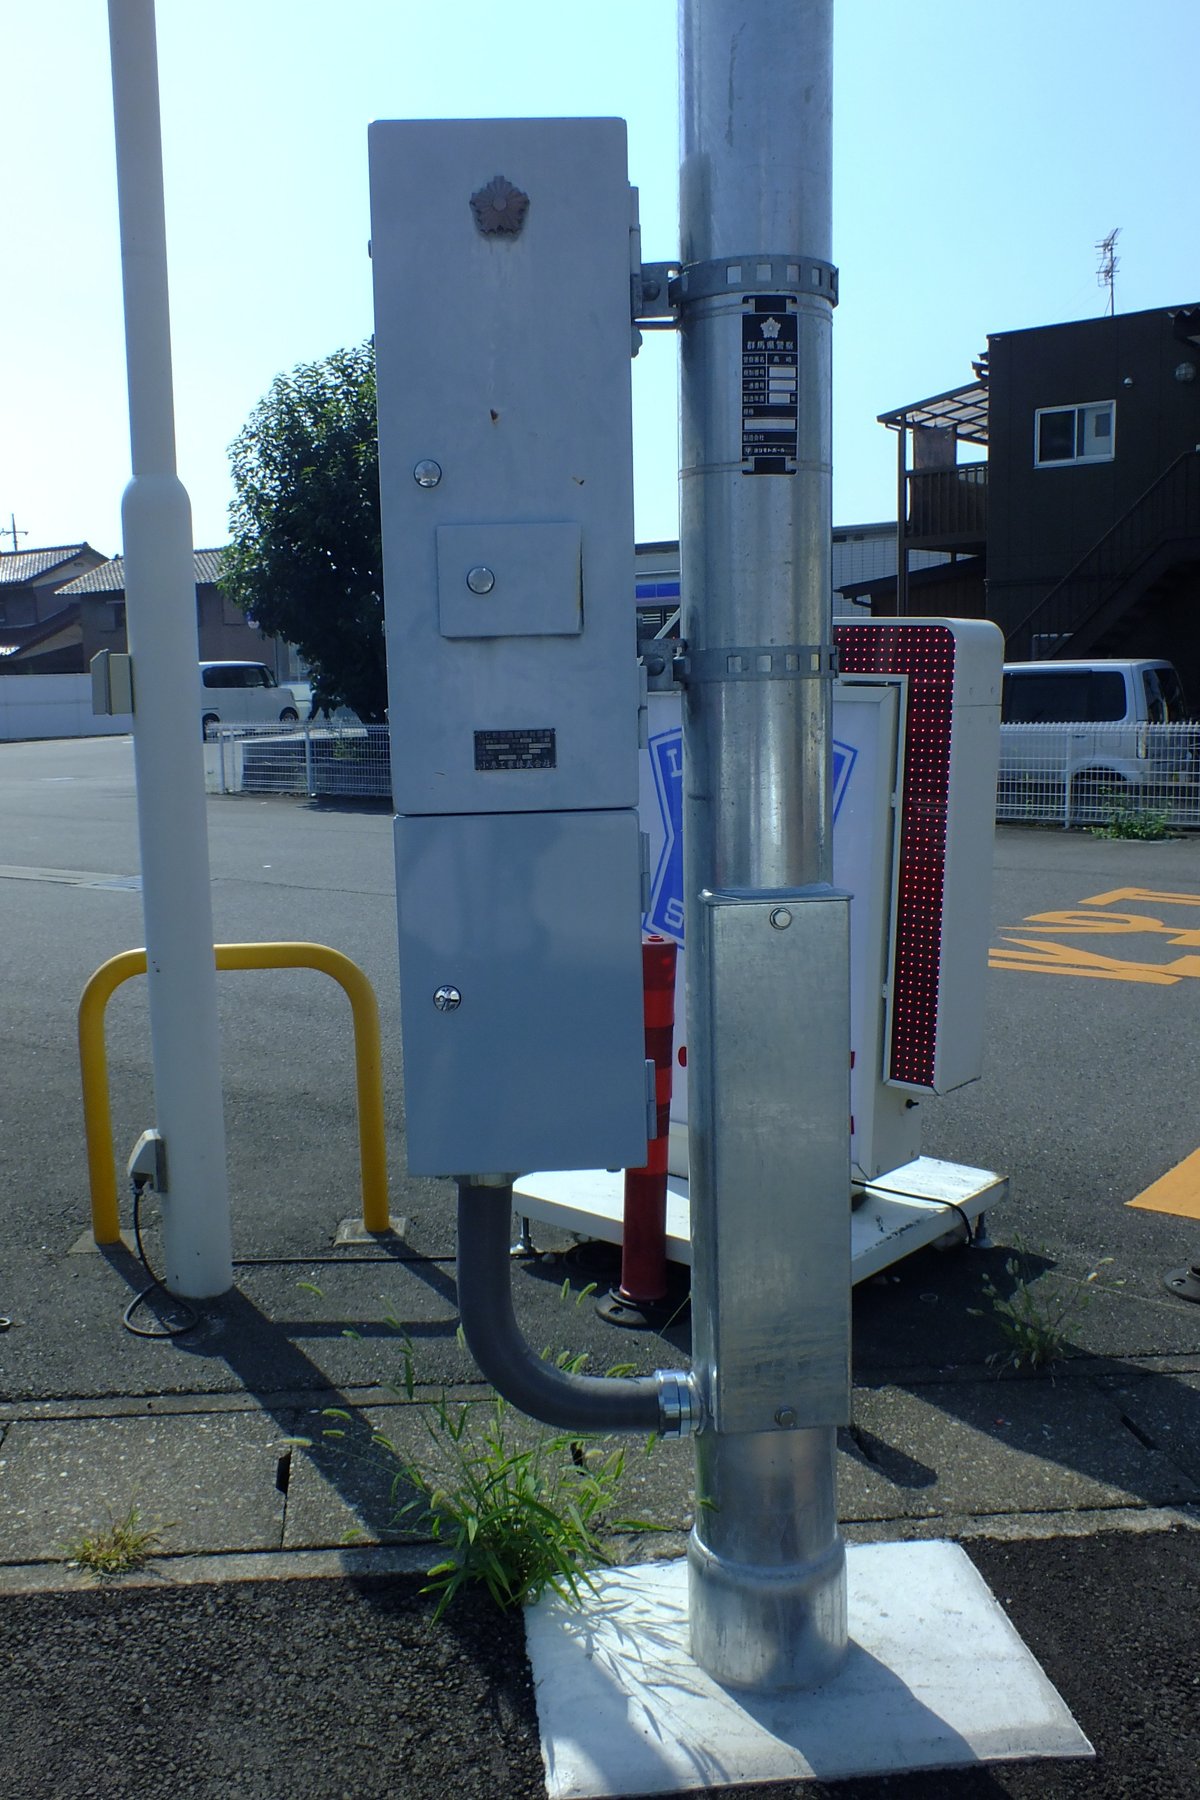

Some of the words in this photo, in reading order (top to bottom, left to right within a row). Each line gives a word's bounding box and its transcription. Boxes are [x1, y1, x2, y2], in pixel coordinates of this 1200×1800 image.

[746, 341, 794, 350] 群馬県警察
